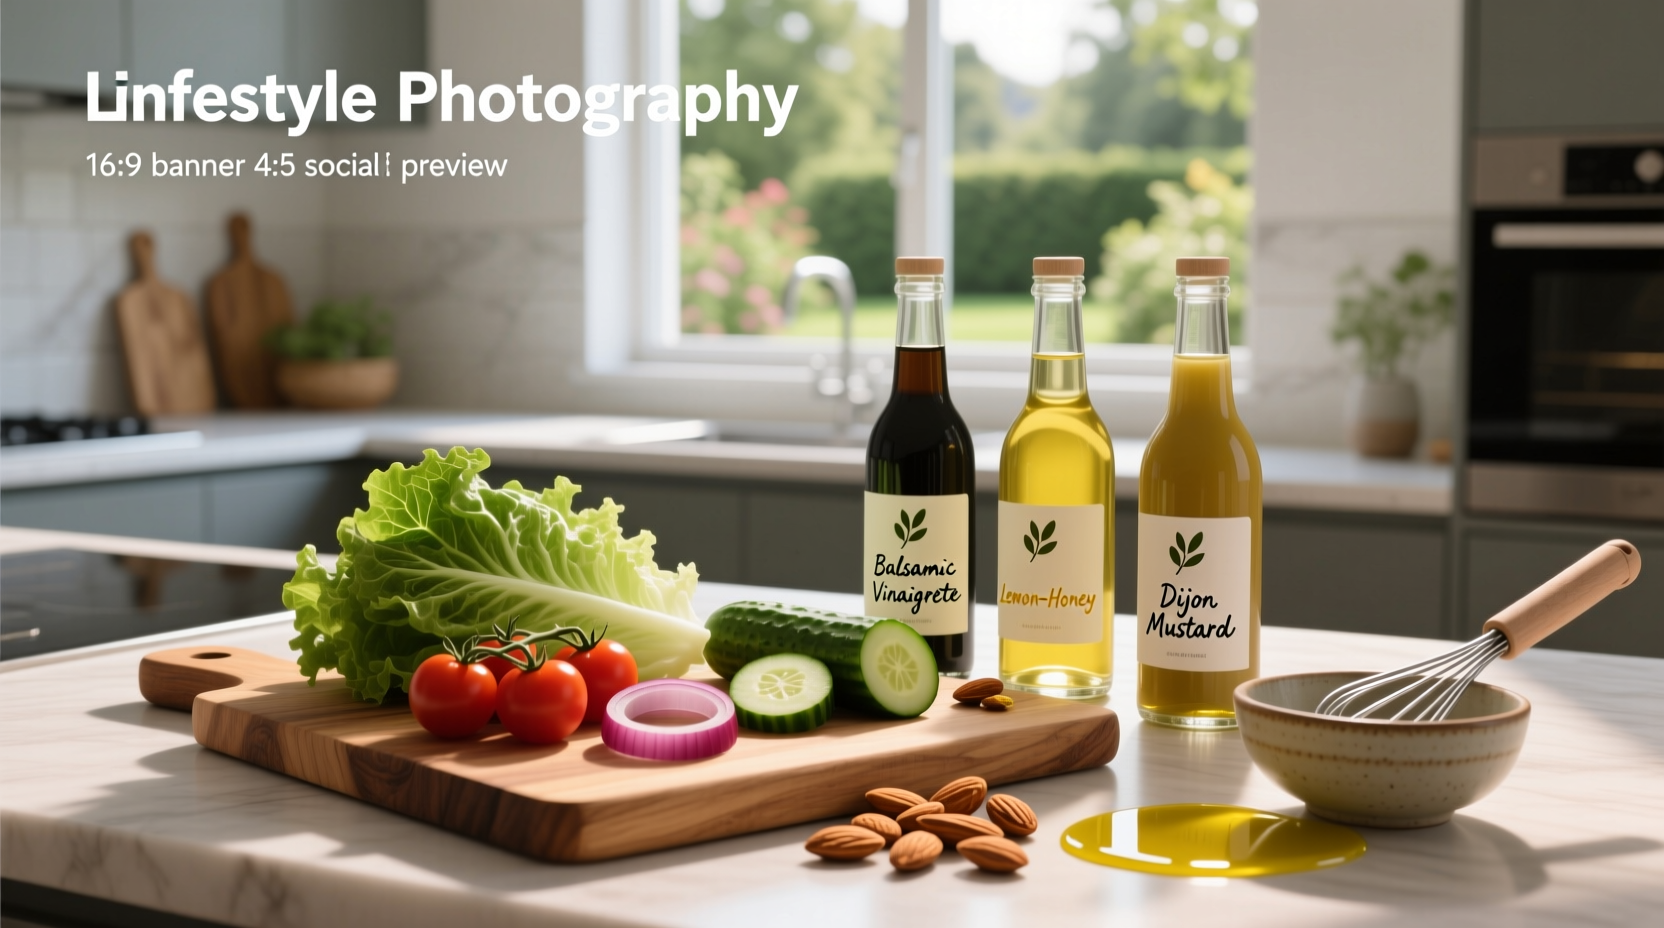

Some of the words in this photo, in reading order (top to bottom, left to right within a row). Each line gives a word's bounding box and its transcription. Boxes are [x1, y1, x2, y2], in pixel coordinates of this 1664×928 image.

[874, 553, 957, 577] Balsamic
[1000, 583, 1097, 615] Lemon-Honey
[1160, 582, 1218, 618] Dijon
[1146, 612, 1236, 639] Mustard
